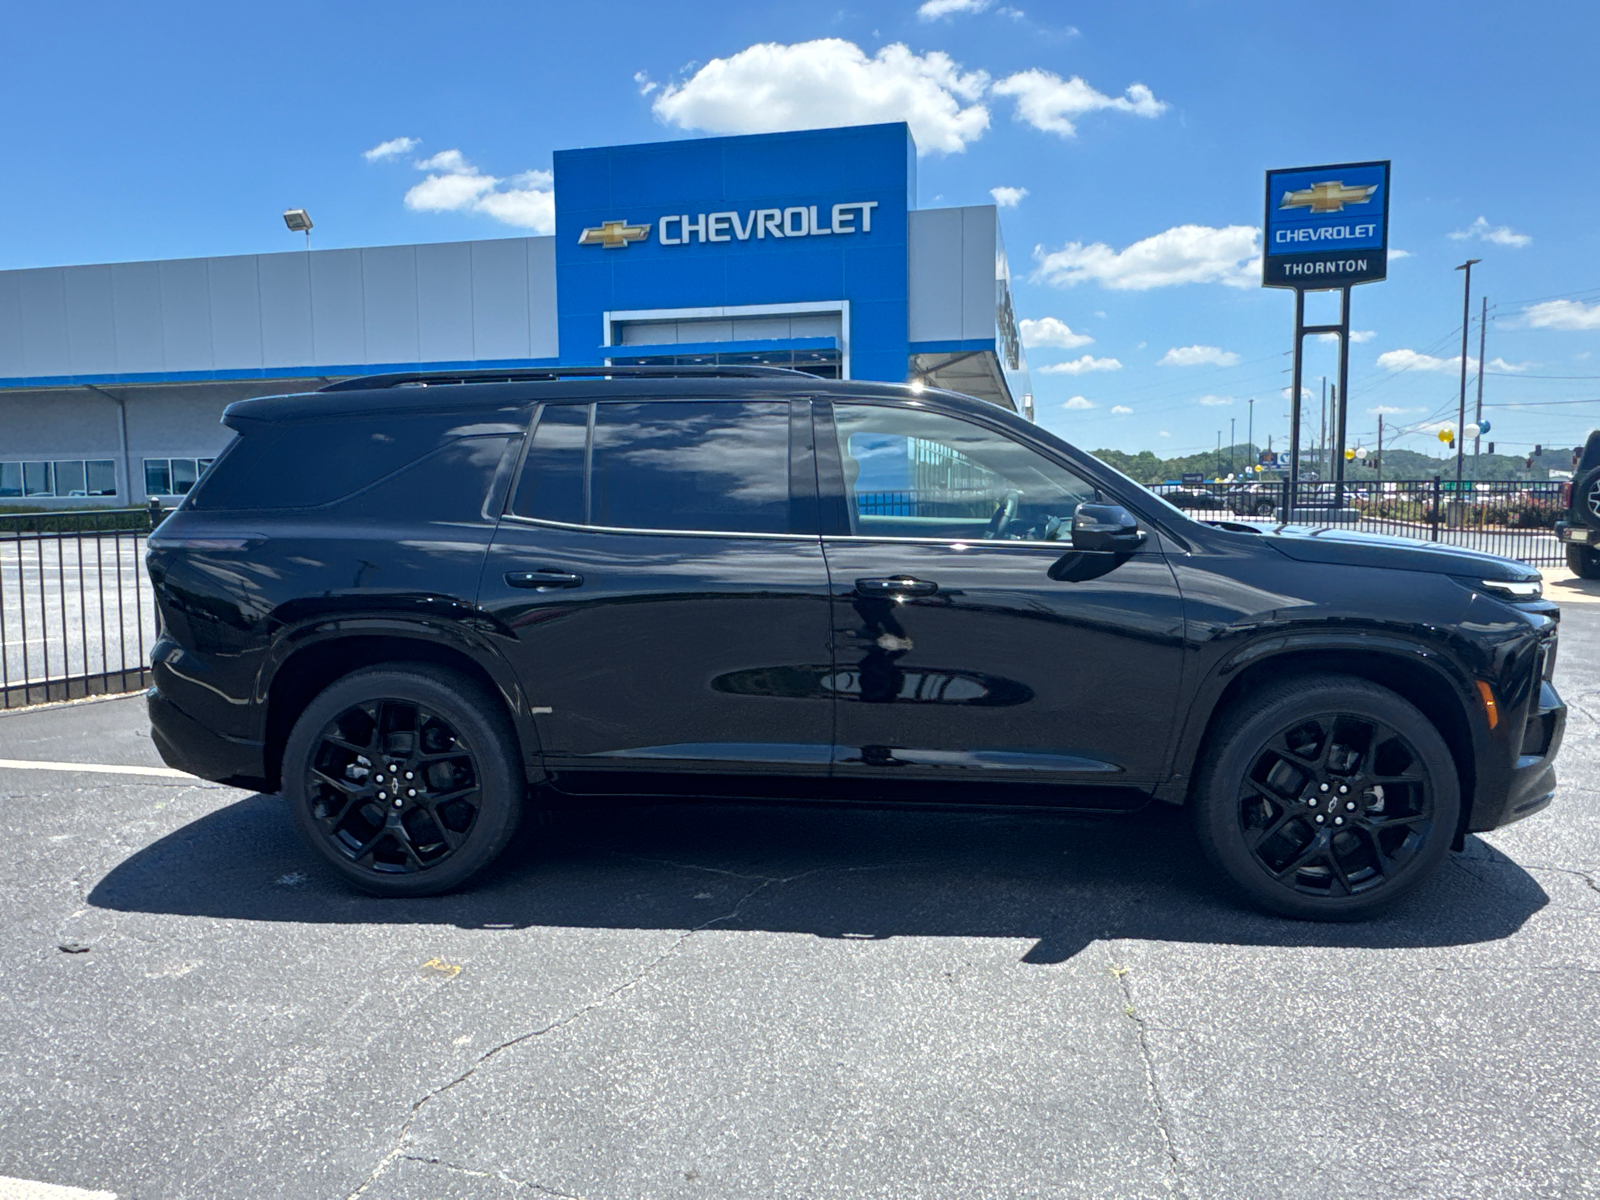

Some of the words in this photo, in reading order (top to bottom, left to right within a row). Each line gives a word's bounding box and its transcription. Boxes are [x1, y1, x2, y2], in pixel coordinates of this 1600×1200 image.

[659, 201, 878, 245] CHEVROLET
[1276, 224, 1376, 243] CHEVROLET
[1284, 259, 1368, 275] THORNTON
